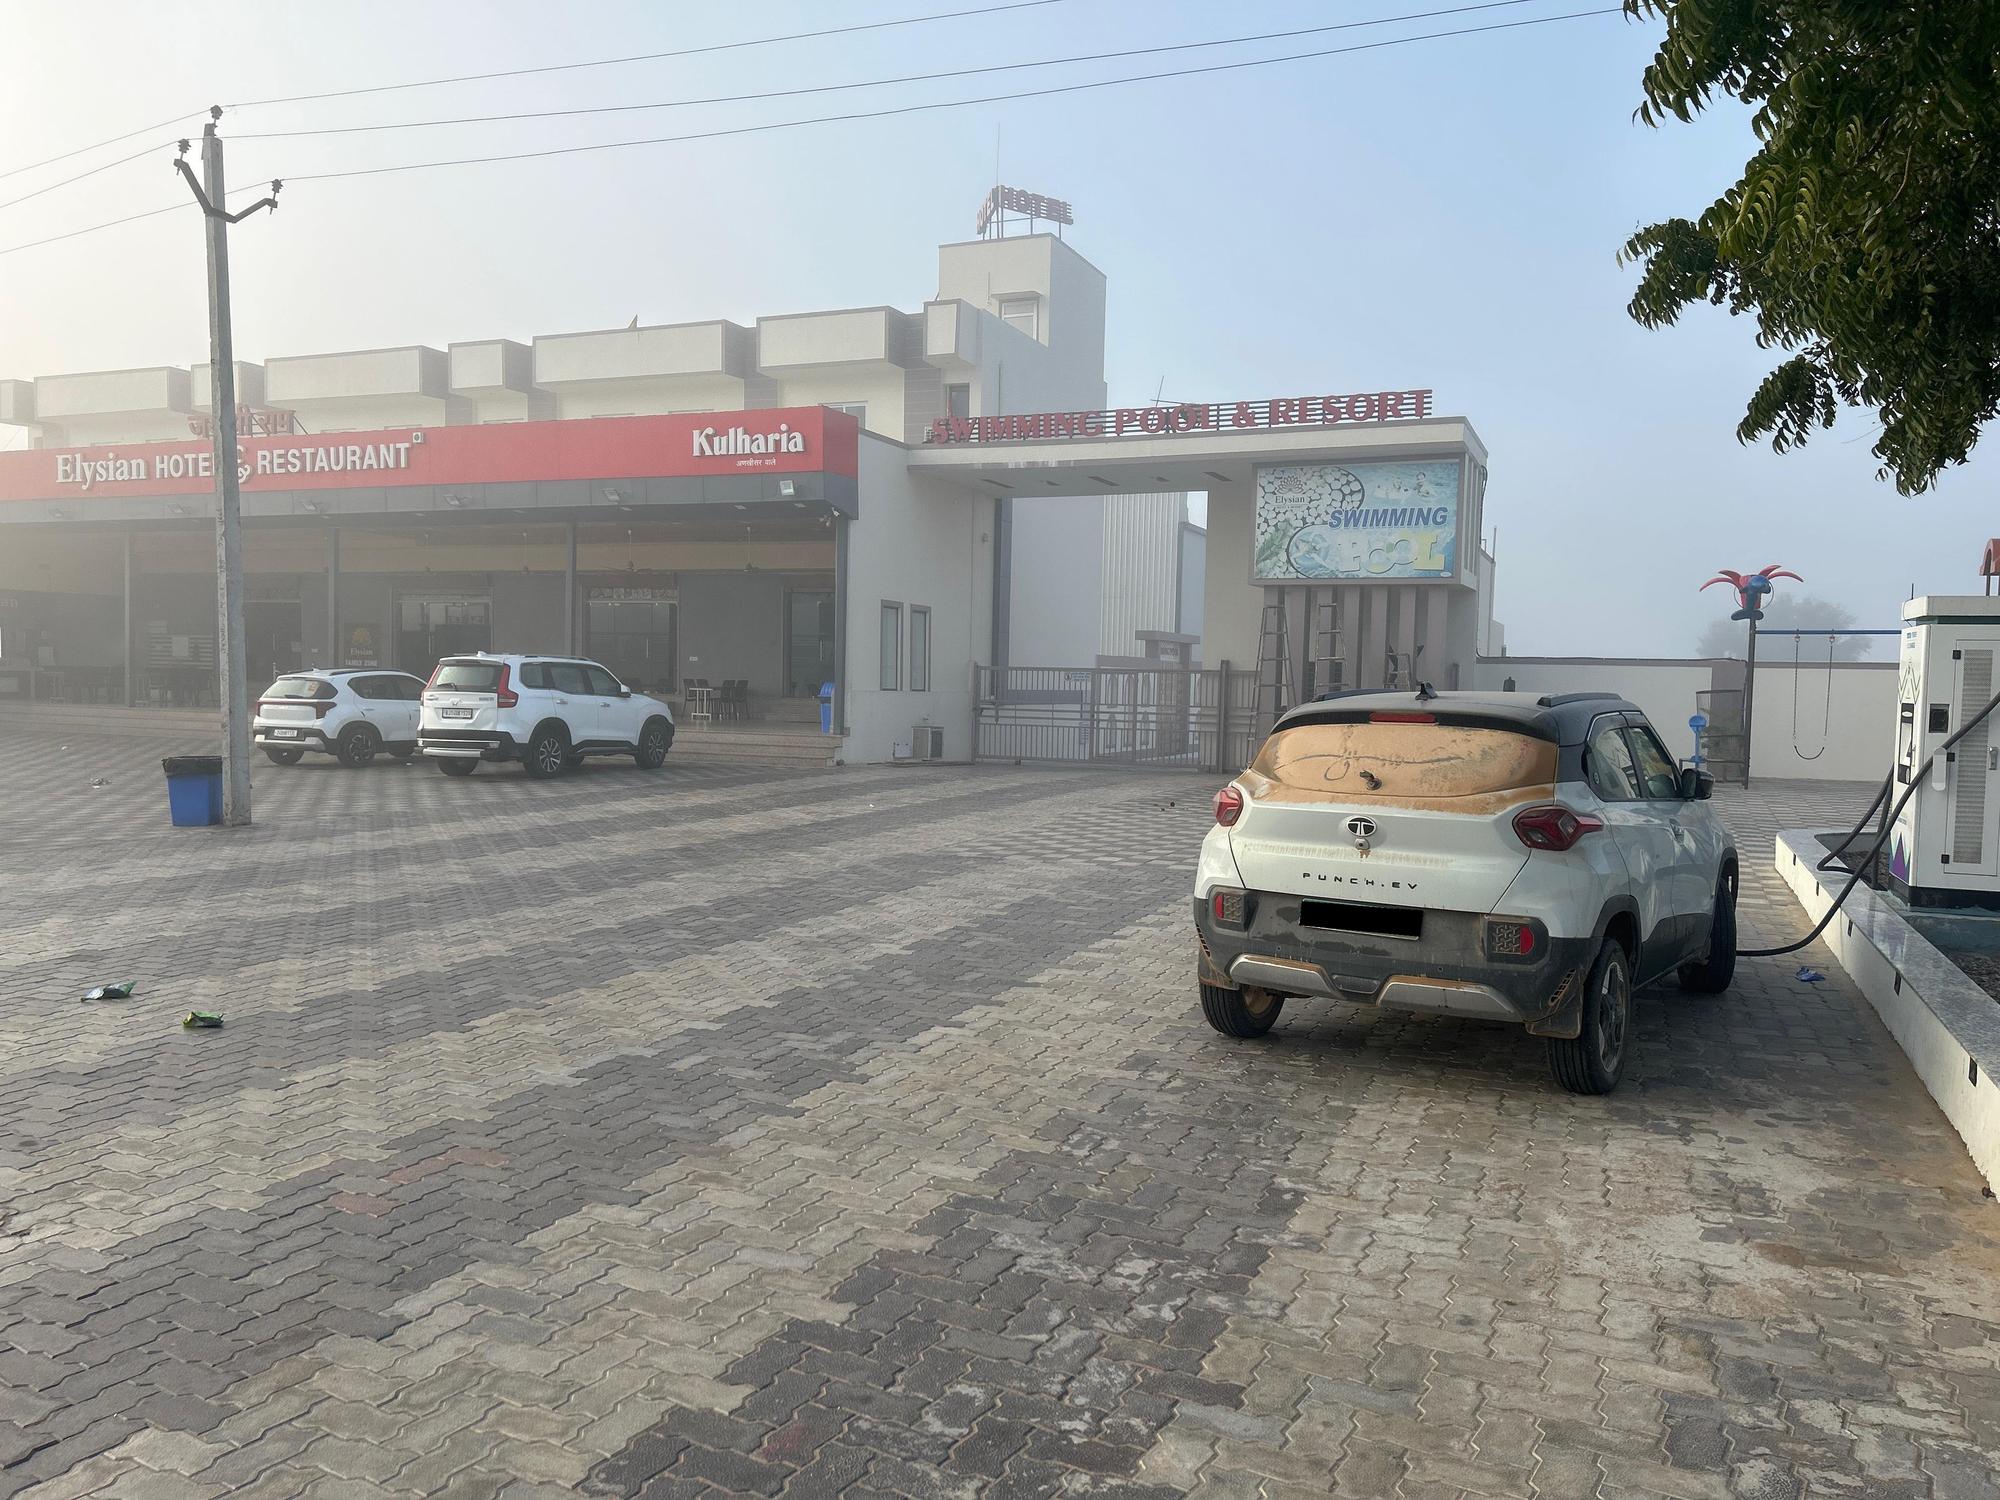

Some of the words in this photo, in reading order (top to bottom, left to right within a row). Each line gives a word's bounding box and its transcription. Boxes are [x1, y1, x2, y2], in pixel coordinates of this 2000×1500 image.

[932, 410, 1104, 445] SWIMMING
[1232, 400, 1258, 428] &
[1270, 388, 1433, 424] RESORT
[692, 423, 805, 457] Kulharia
[55, 451, 146, 490] Elysian
[155, 451, 217, 479] HOTE
[257, 442, 411, 474] RESTAURANT
[1274, 495, 1306, 505] Elysian
[1328, 506, 1449, 529] SWIMMING
